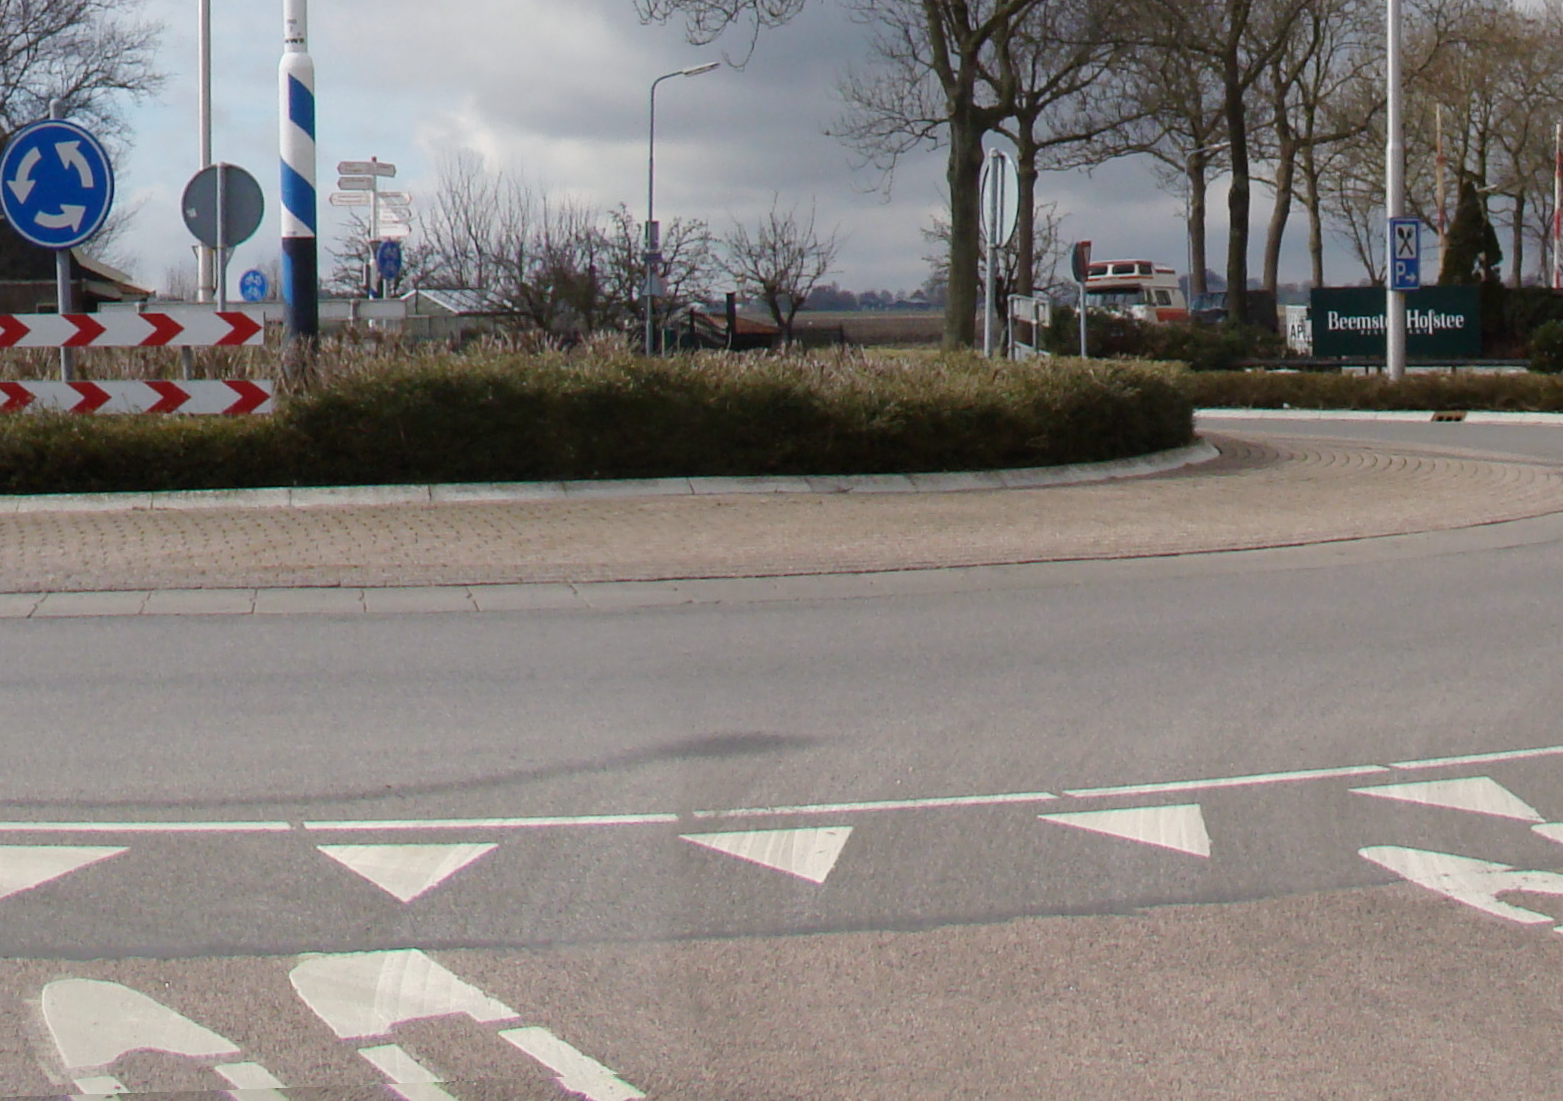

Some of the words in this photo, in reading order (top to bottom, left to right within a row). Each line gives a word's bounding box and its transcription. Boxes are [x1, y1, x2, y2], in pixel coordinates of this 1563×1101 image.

[1395, 261, 1406, 284] P
[1328, 311, 1387, 331] Beemst
[1407, 308, 1465, 335] Hofstee
